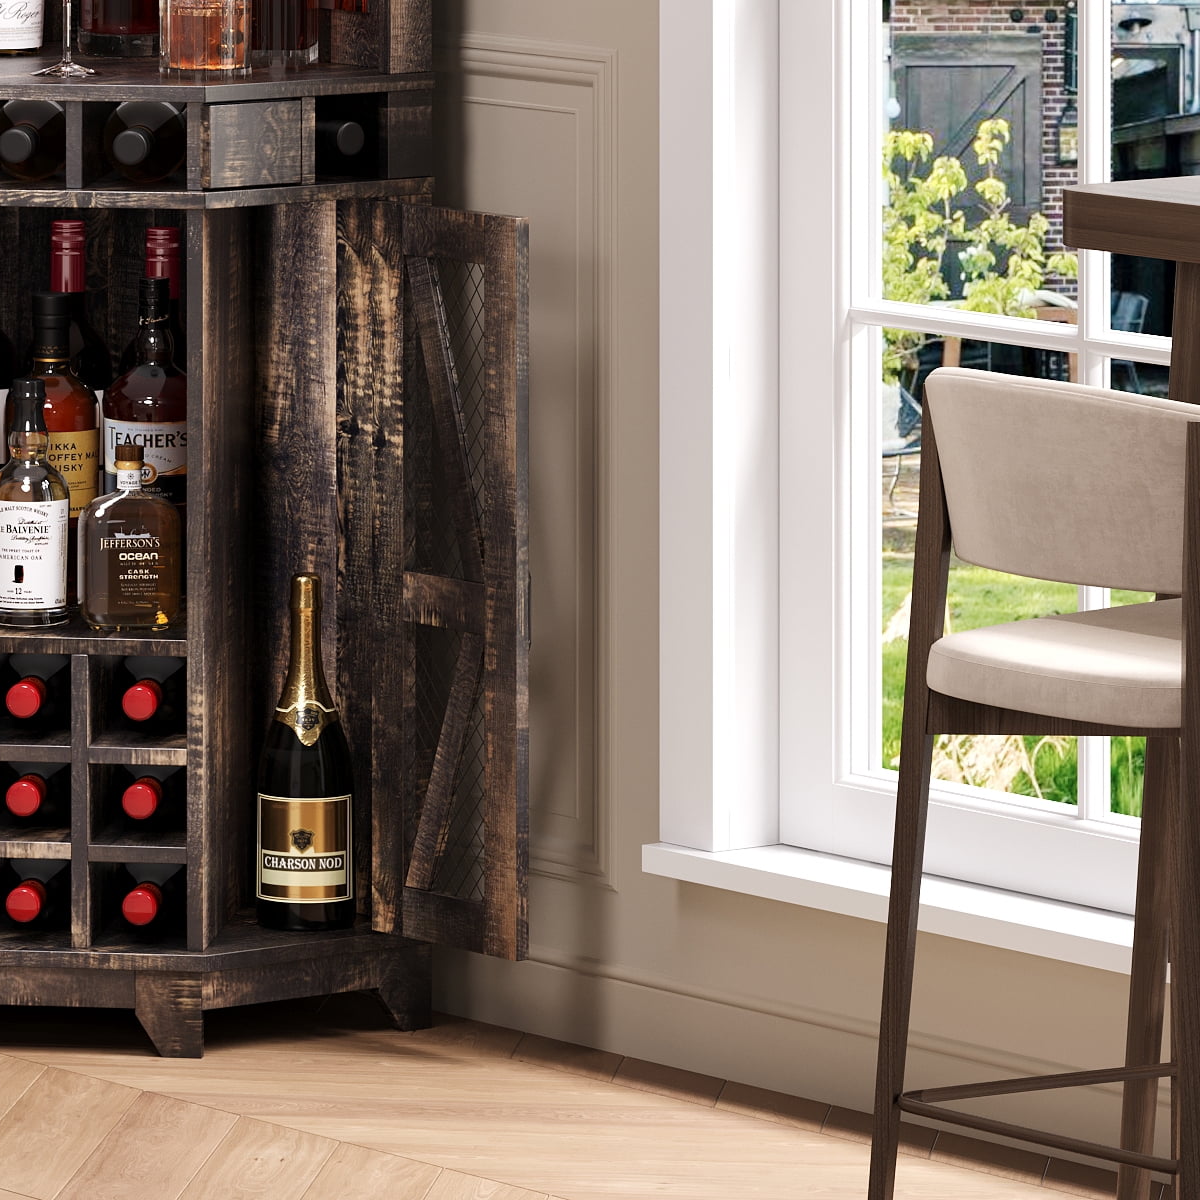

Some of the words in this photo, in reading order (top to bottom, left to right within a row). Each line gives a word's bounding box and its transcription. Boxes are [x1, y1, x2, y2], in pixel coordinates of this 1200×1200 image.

[108, 426, 187, 450] TEACHER'S
[50, 443, 77, 451] IKKA
[48, 453, 83, 462] OFFEY
[54, 464, 84, 472] ISKY
[6, 524, 49, 534] BALVENIE
[100, 537, 161, 551] JEFFERSON'S
[15, 587, 23, 595] 12
[264, 855, 316, 870] CHARSON
[319, 857, 342, 869] NOD
